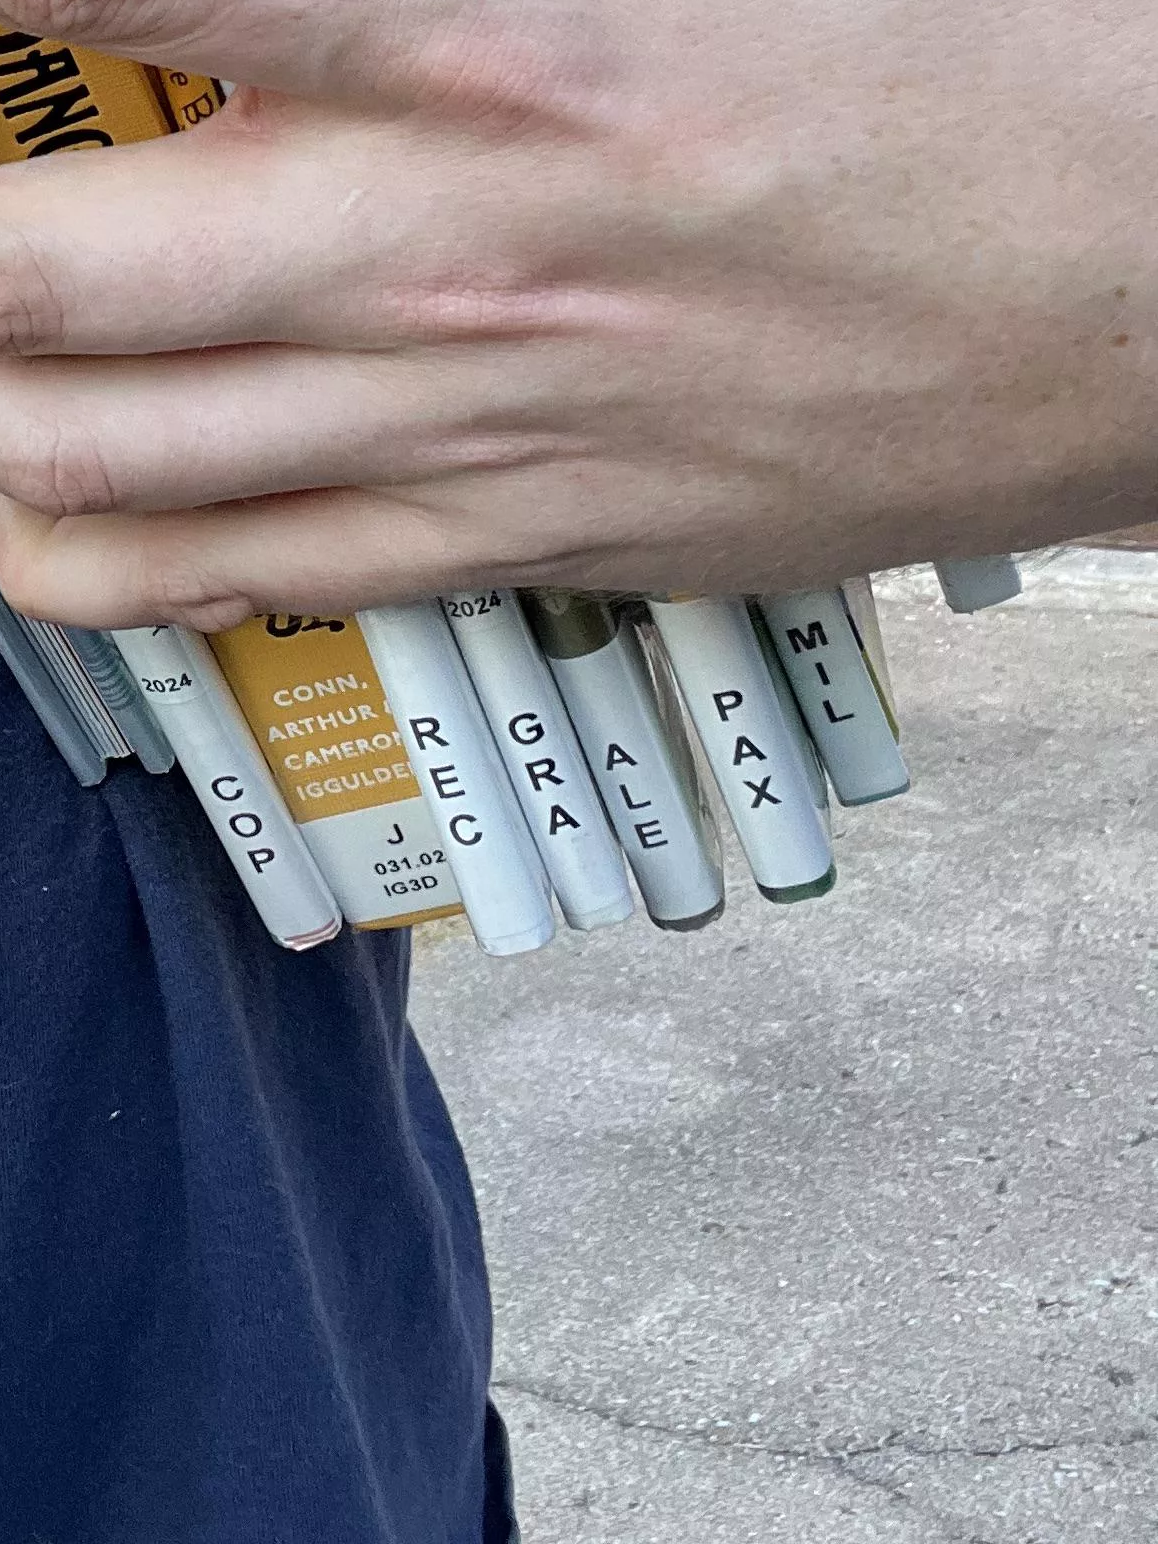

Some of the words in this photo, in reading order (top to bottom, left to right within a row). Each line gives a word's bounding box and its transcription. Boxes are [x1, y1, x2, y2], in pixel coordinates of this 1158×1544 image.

[447, 590, 503, 620] 2024
[141, 673, 193, 693] 2024
[272, 672, 369, 707] CONN.
[787, 620, 854, 725] MIL
[267, 703, 379, 744] ARTHUR
[712, 688, 783, 810] PAX
[296, 760, 419, 801] IGGULDE
[409, 716, 483, 846] REC
[508, 712, 581, 836] GRA
[605, 743, 669, 850] ALE
[211, 775, 276, 875] COP
[386, 823, 405, 845] J
[374, 849, 448, 876] 031.02
[383, 874, 439, 897] IG3D
